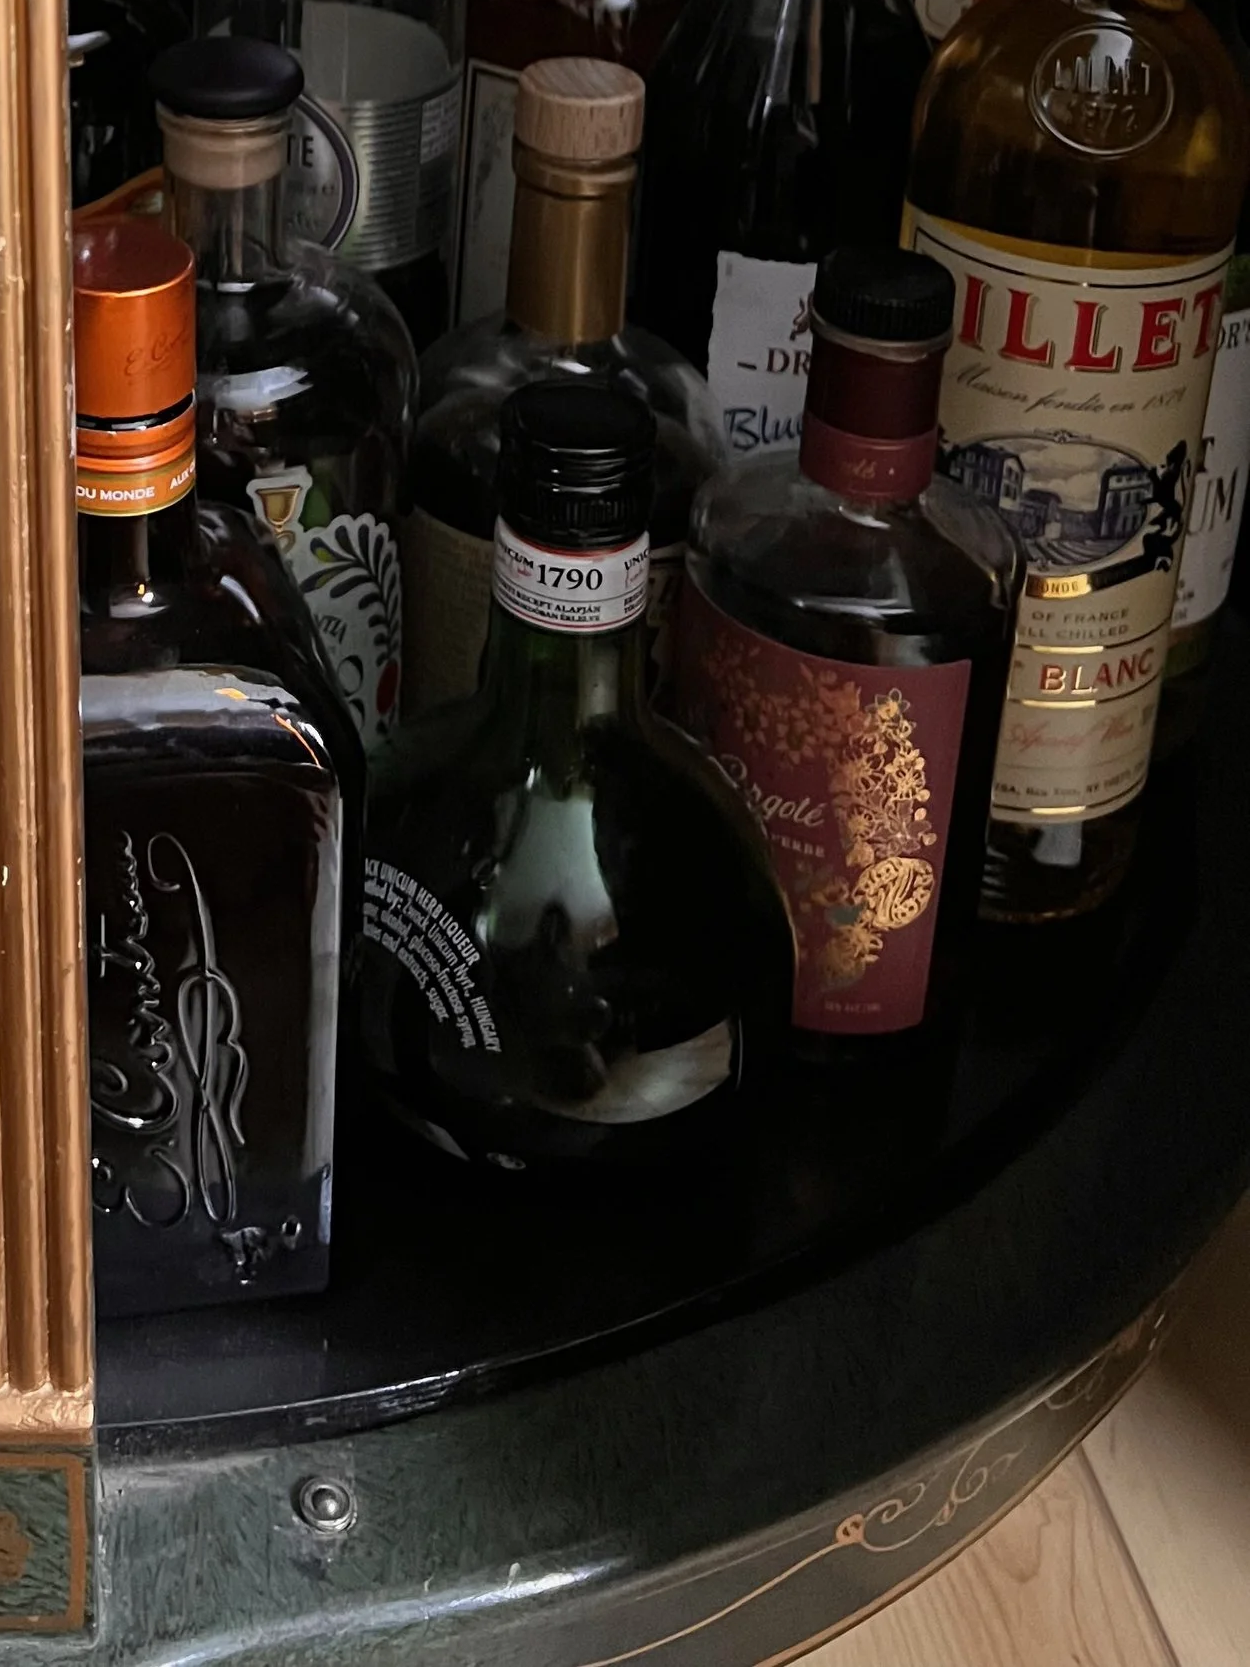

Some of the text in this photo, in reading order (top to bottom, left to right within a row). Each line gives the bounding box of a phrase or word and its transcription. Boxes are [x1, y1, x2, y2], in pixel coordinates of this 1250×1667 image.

[286, 134, 314, 168] TE
[958, 274, 1225, 374] ILLET
[75, 485, 156, 502] DU MONDE
[536, 563, 604, 591] 1790
[1031, 607, 1131, 625] OF FRANCE
[1055, 623, 1130, 641] CHILLED
[1039, 647, 1156, 696] BLANC
[415, 885, 442, 920] HERB
[438, 906, 481, 967] LIQUEUR
[427, 922, 459, 968] Unicum
[469, 994, 503, 1054] HUNGARY
